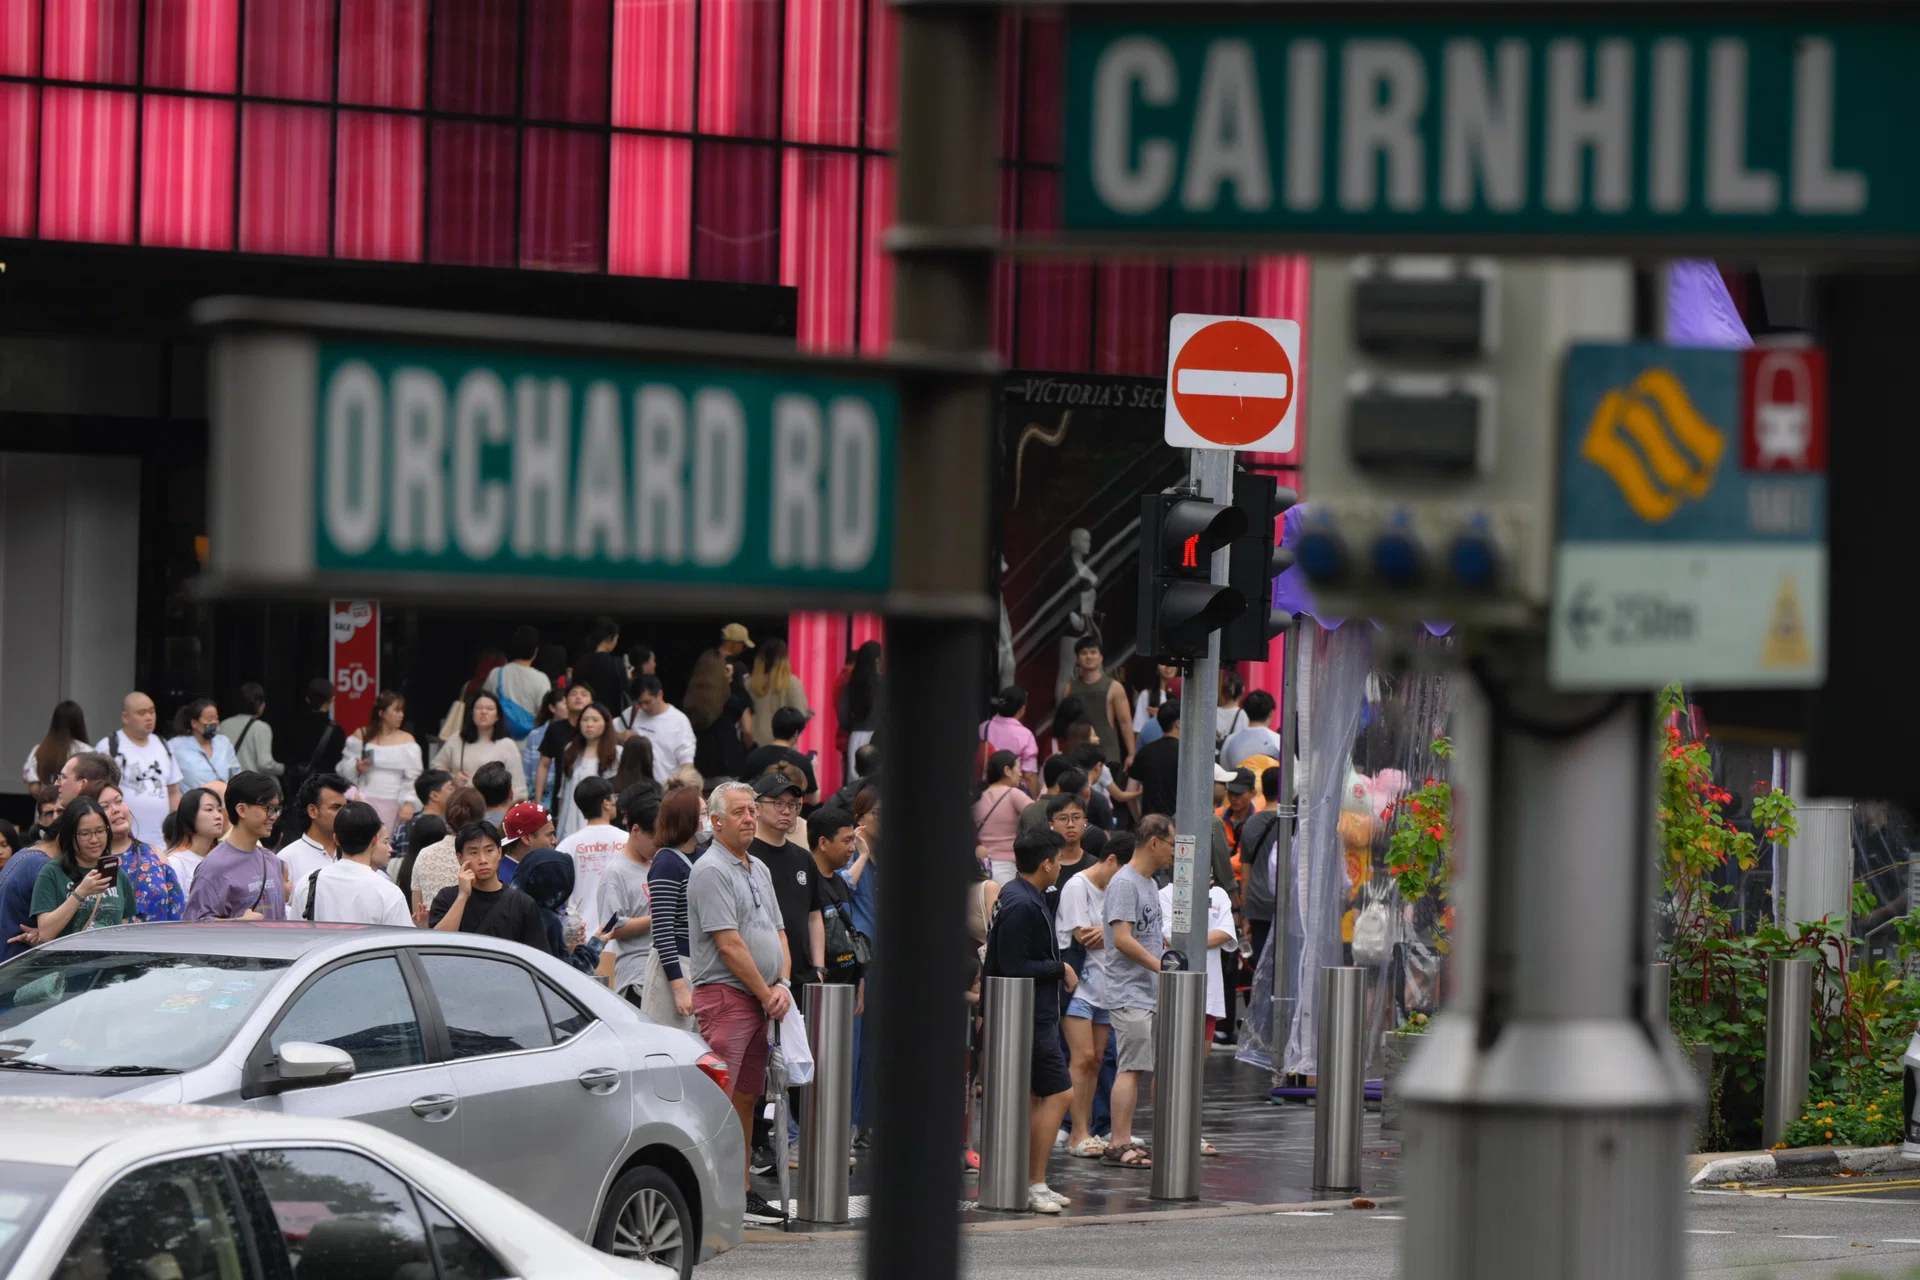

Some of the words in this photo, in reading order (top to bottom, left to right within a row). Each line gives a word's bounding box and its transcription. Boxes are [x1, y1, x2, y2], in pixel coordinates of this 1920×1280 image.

[1091, 35, 1865, 214] CAIRNHILL
[1025, 378, 1126, 406] VICTORIA'S
[1128, 384, 1166, 408] SEC
[324, 360, 746, 567] ORCHARD
[770, 394, 879, 571] RD
[335, 623, 350, 631] SALE
